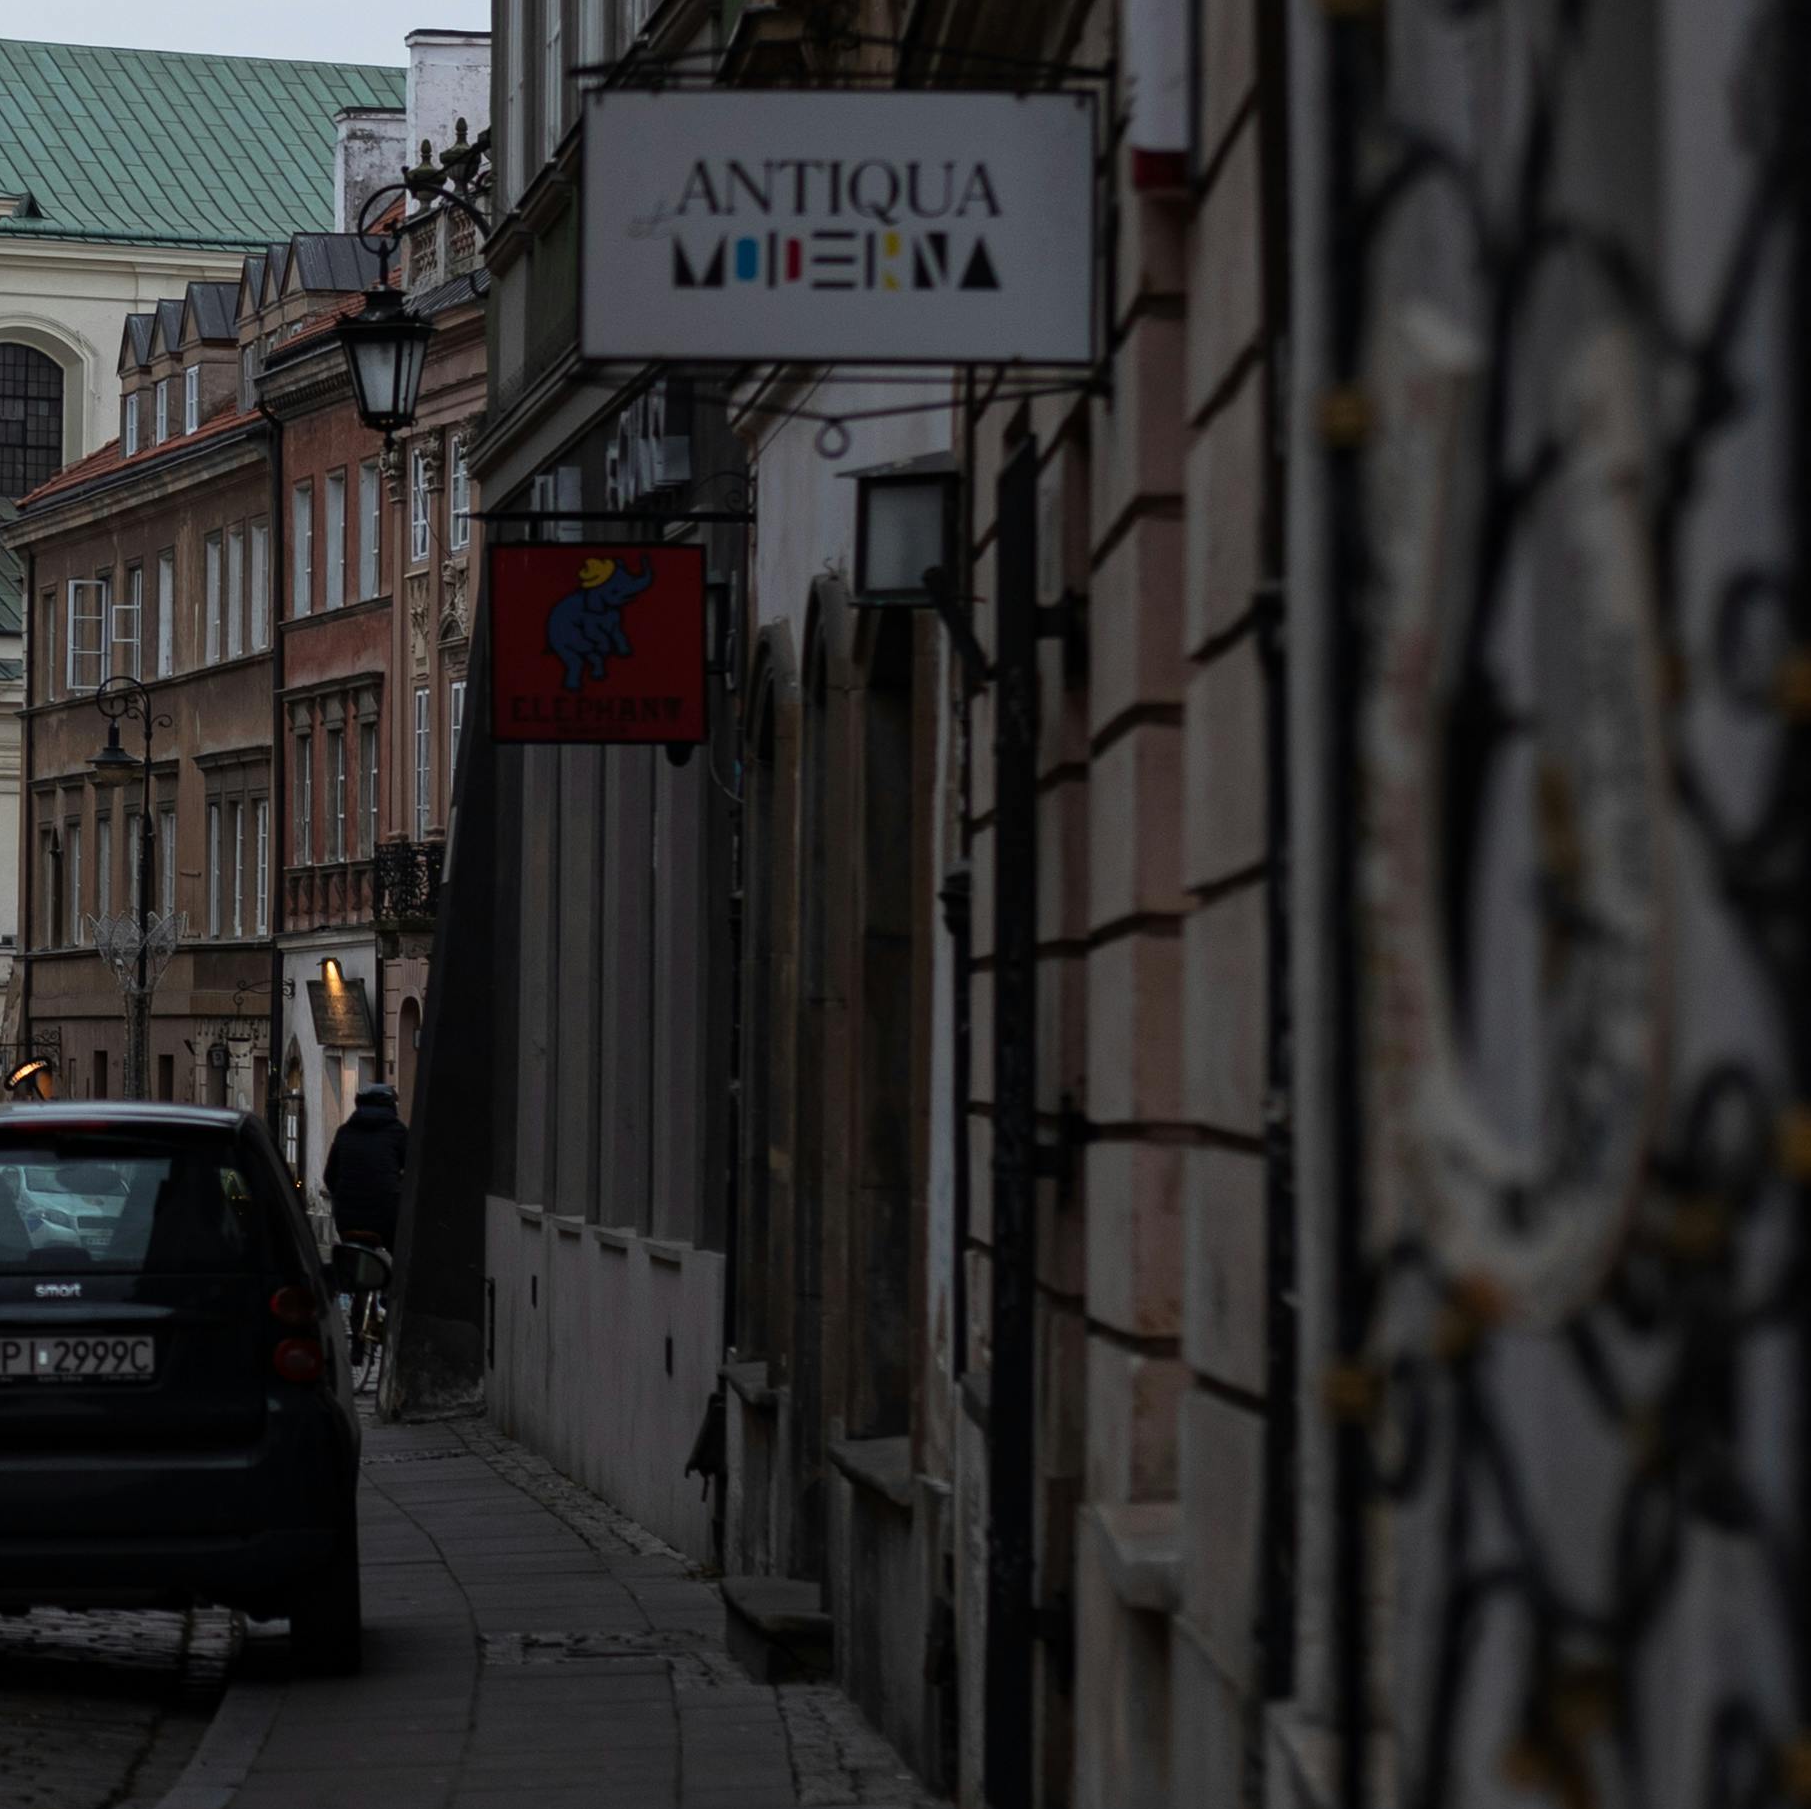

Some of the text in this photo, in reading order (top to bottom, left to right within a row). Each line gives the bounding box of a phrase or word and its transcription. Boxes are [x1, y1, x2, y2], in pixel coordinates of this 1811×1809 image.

[676, 159, 1002, 225] ANTIQUA
[673, 231, 1001, 291] MODERNA
[512, 696, 683, 723] ELEPHANT
[35, 1283, 82, 1298] smart
[54, 1341, 150, 1374] 2999C
